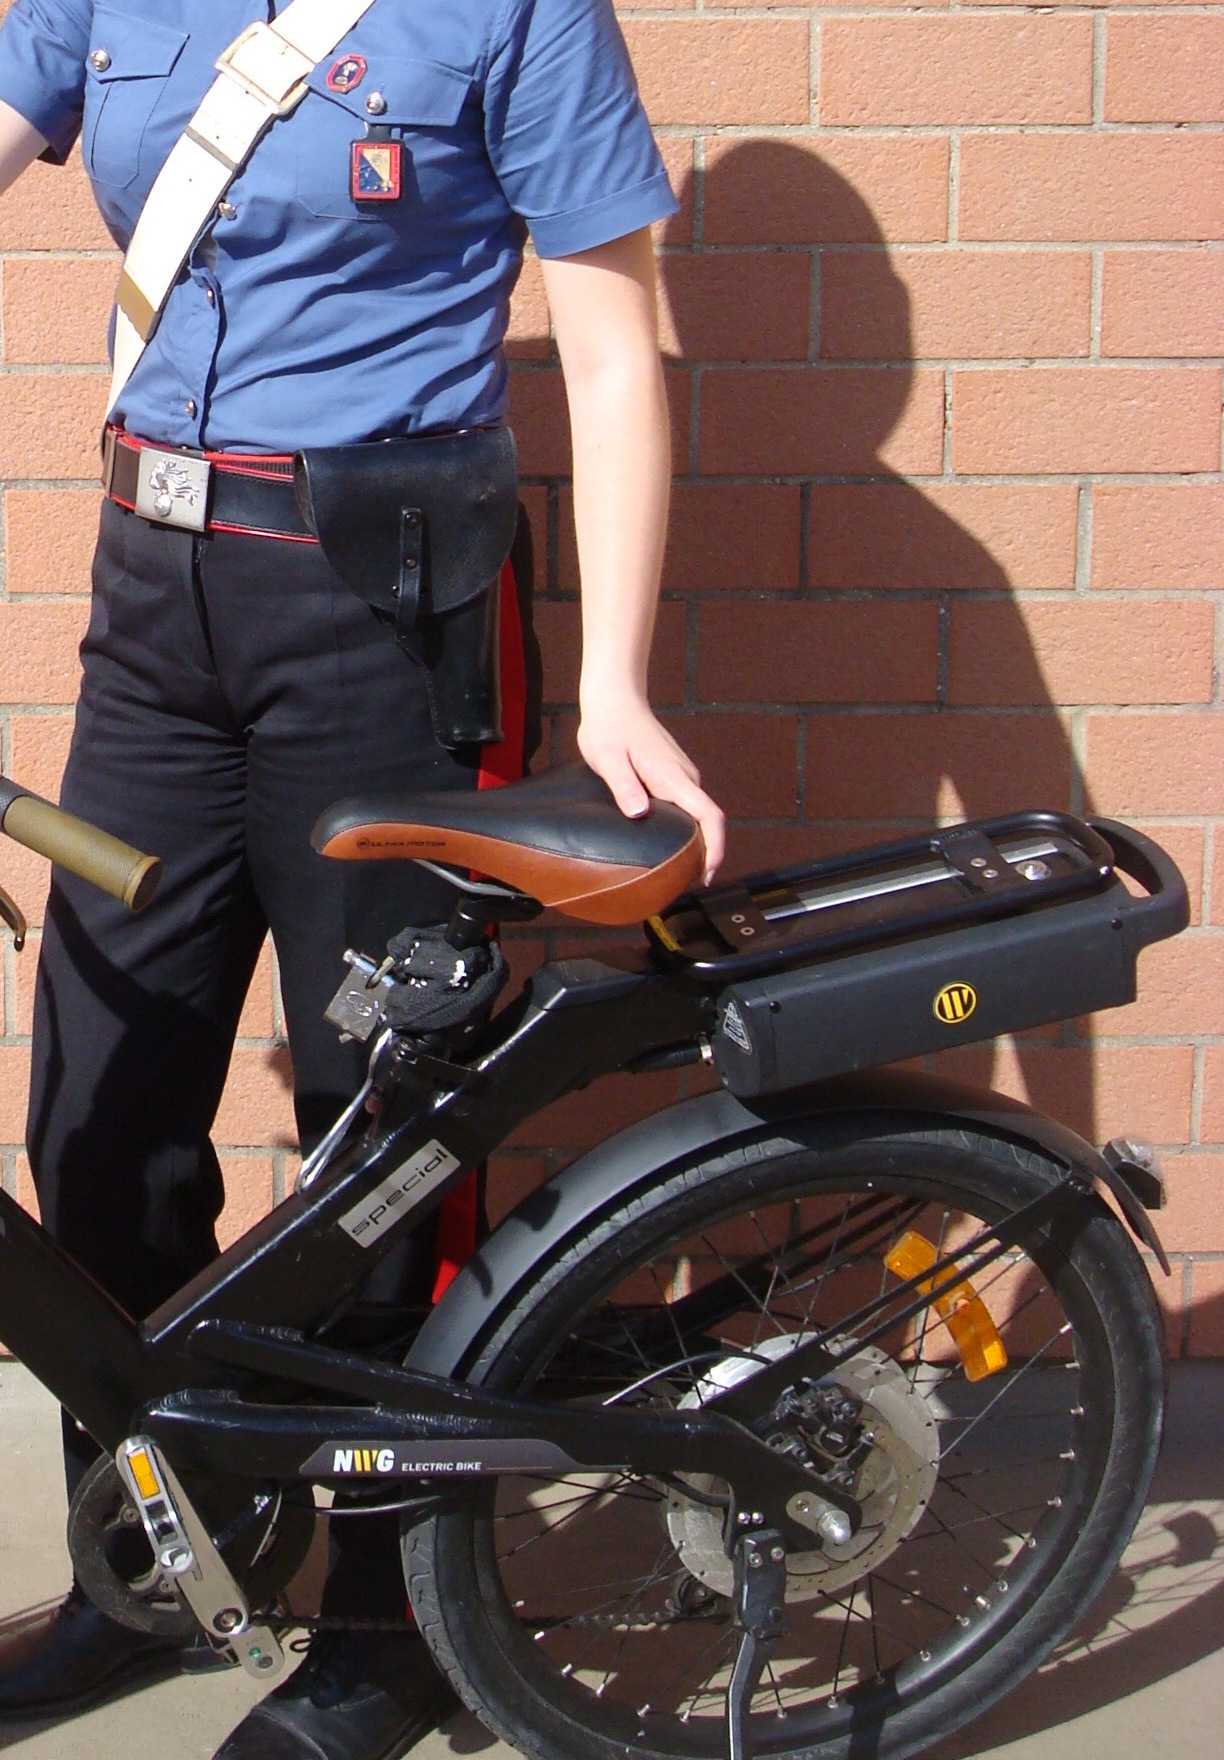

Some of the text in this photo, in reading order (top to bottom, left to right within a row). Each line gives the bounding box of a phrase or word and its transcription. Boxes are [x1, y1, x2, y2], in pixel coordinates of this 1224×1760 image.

[352, 1148, 448, 1236] special
[401, 1462, 454, 1471] ELECTRIC
[456, 1462, 482, 1471] BIKE
